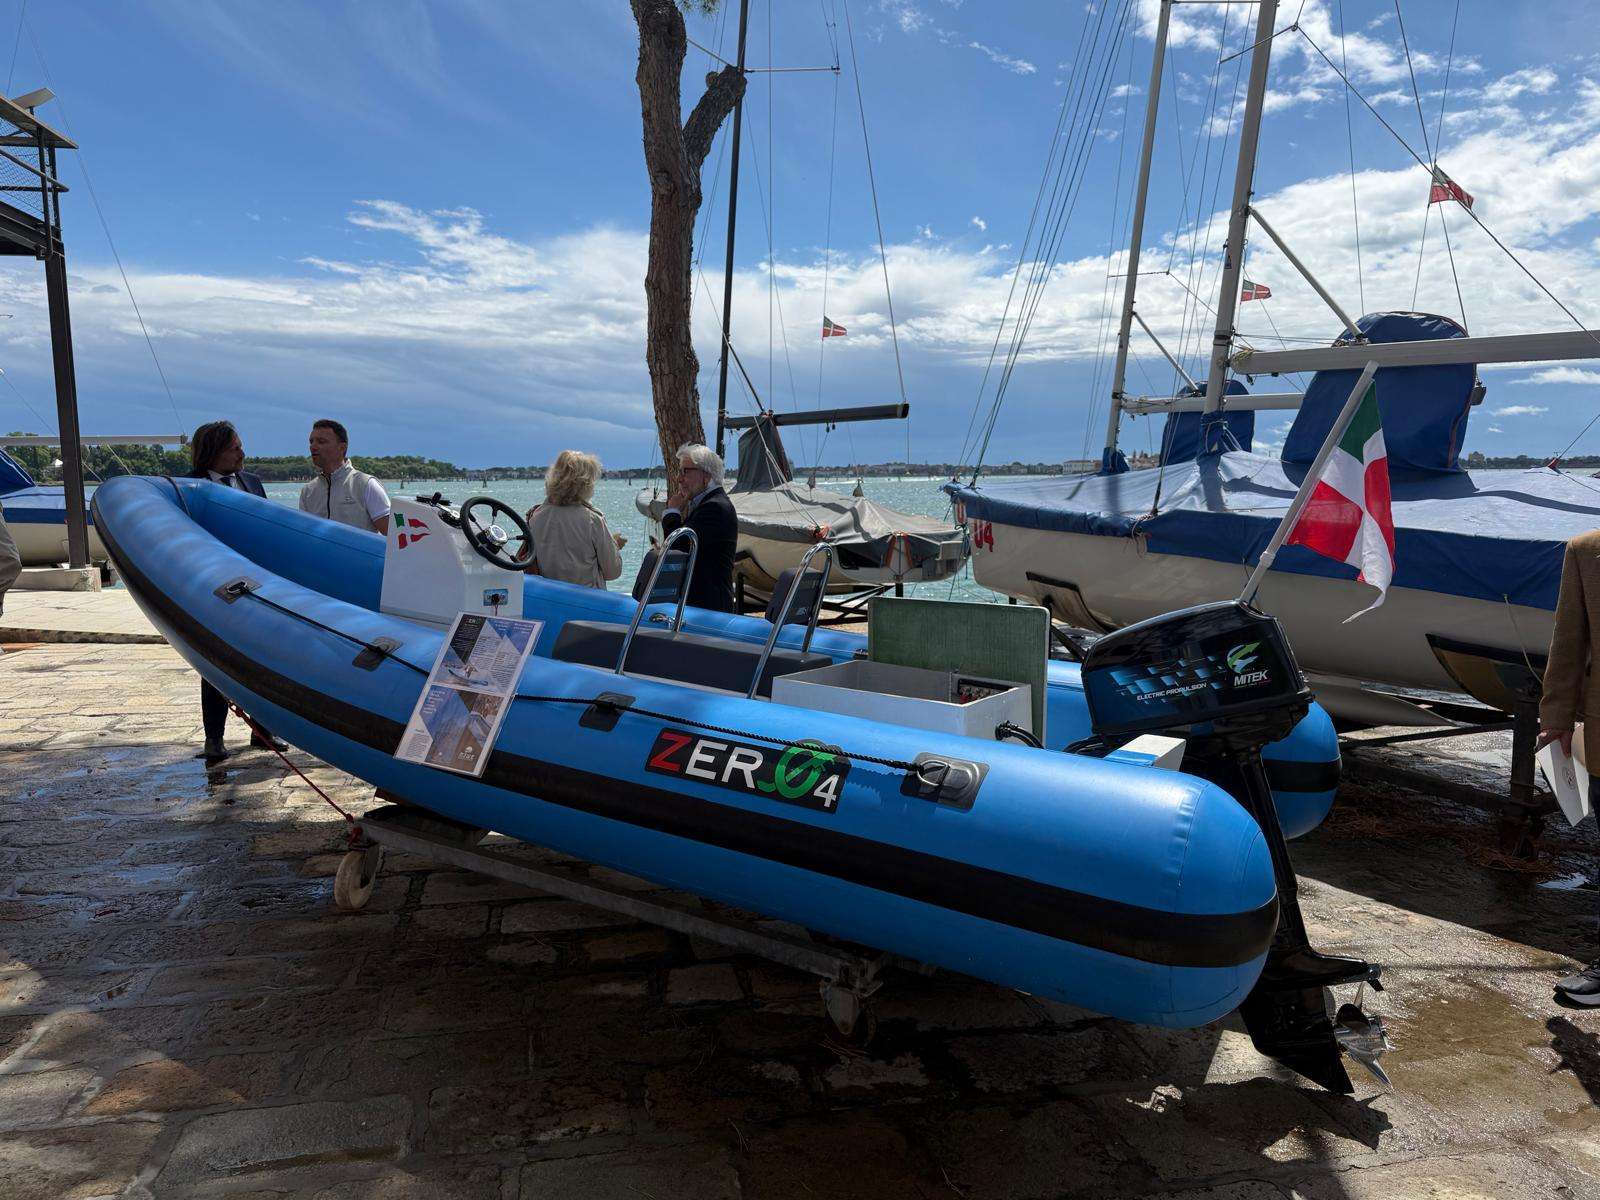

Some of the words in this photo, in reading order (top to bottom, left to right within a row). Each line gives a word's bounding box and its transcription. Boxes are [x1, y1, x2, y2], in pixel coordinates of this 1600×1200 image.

[1233, 669, 1268, 687] MITEK
[1136, 690, 1165, 701] ELECTRIC
[1165, 682, 1207, 696] PROPULSION
